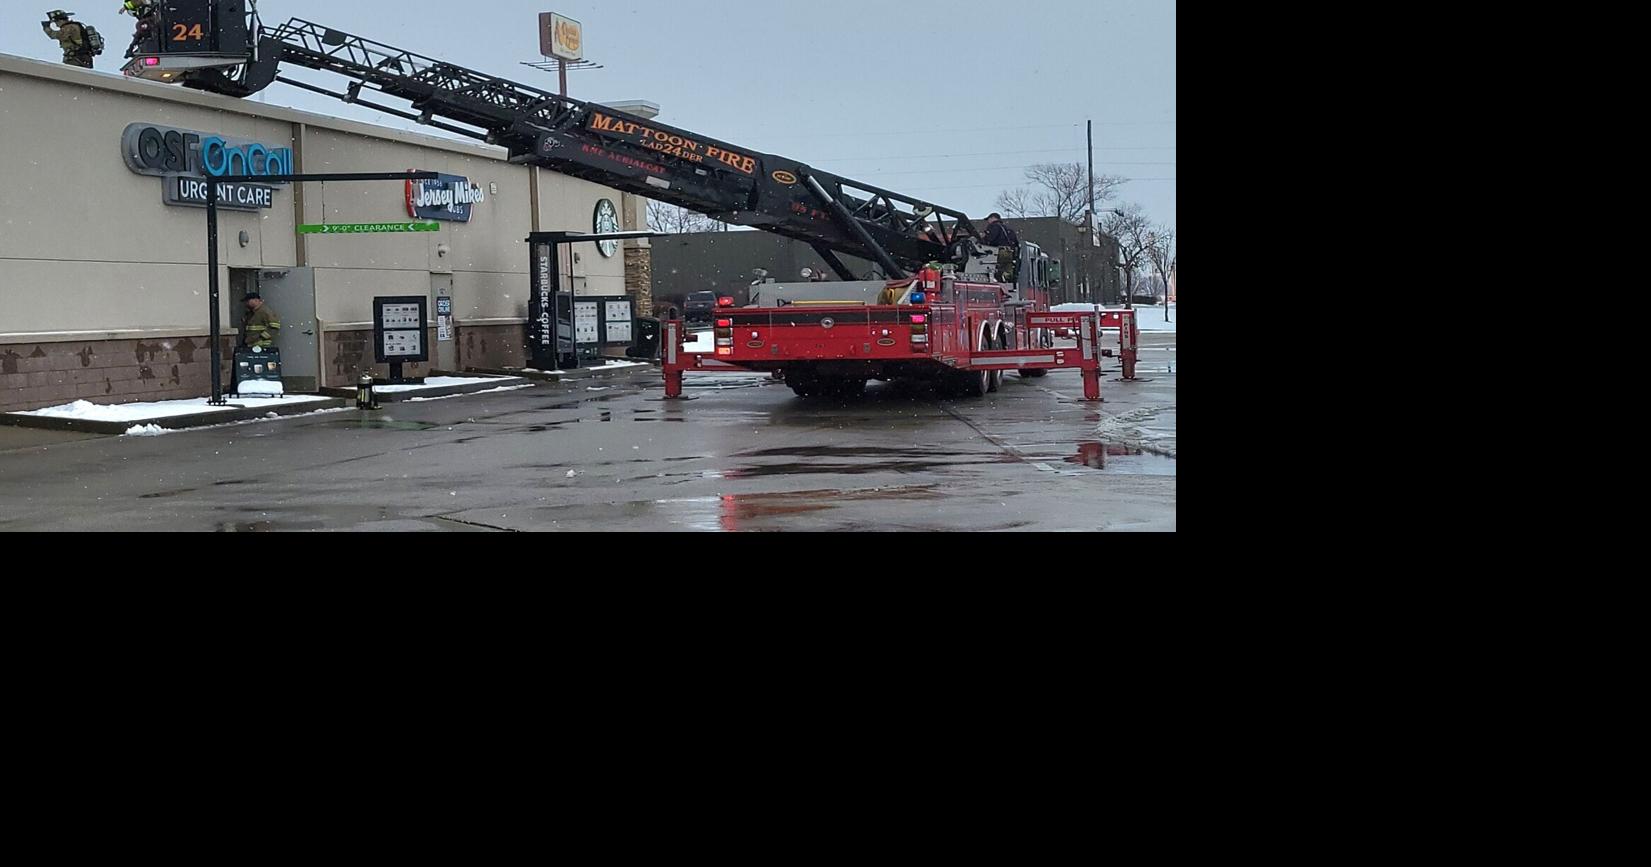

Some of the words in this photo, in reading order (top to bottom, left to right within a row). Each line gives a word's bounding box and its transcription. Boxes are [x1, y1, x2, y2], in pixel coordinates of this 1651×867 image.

[172, 23, 204, 41] 24
[138, 127, 200, 172] OSF
[591, 112, 697, 151] MATTOON
[704, 145, 757, 175] FIRE
[179, 178, 234, 202] URGNT
[236, 185, 272, 206] CARE
[416, 181, 454, 213] Jersey
[353, 224, 405, 232] CLEARANCE
[539, 256, 551, 308] STARBUCKS
[541, 312, 550, 346] COFFEE
